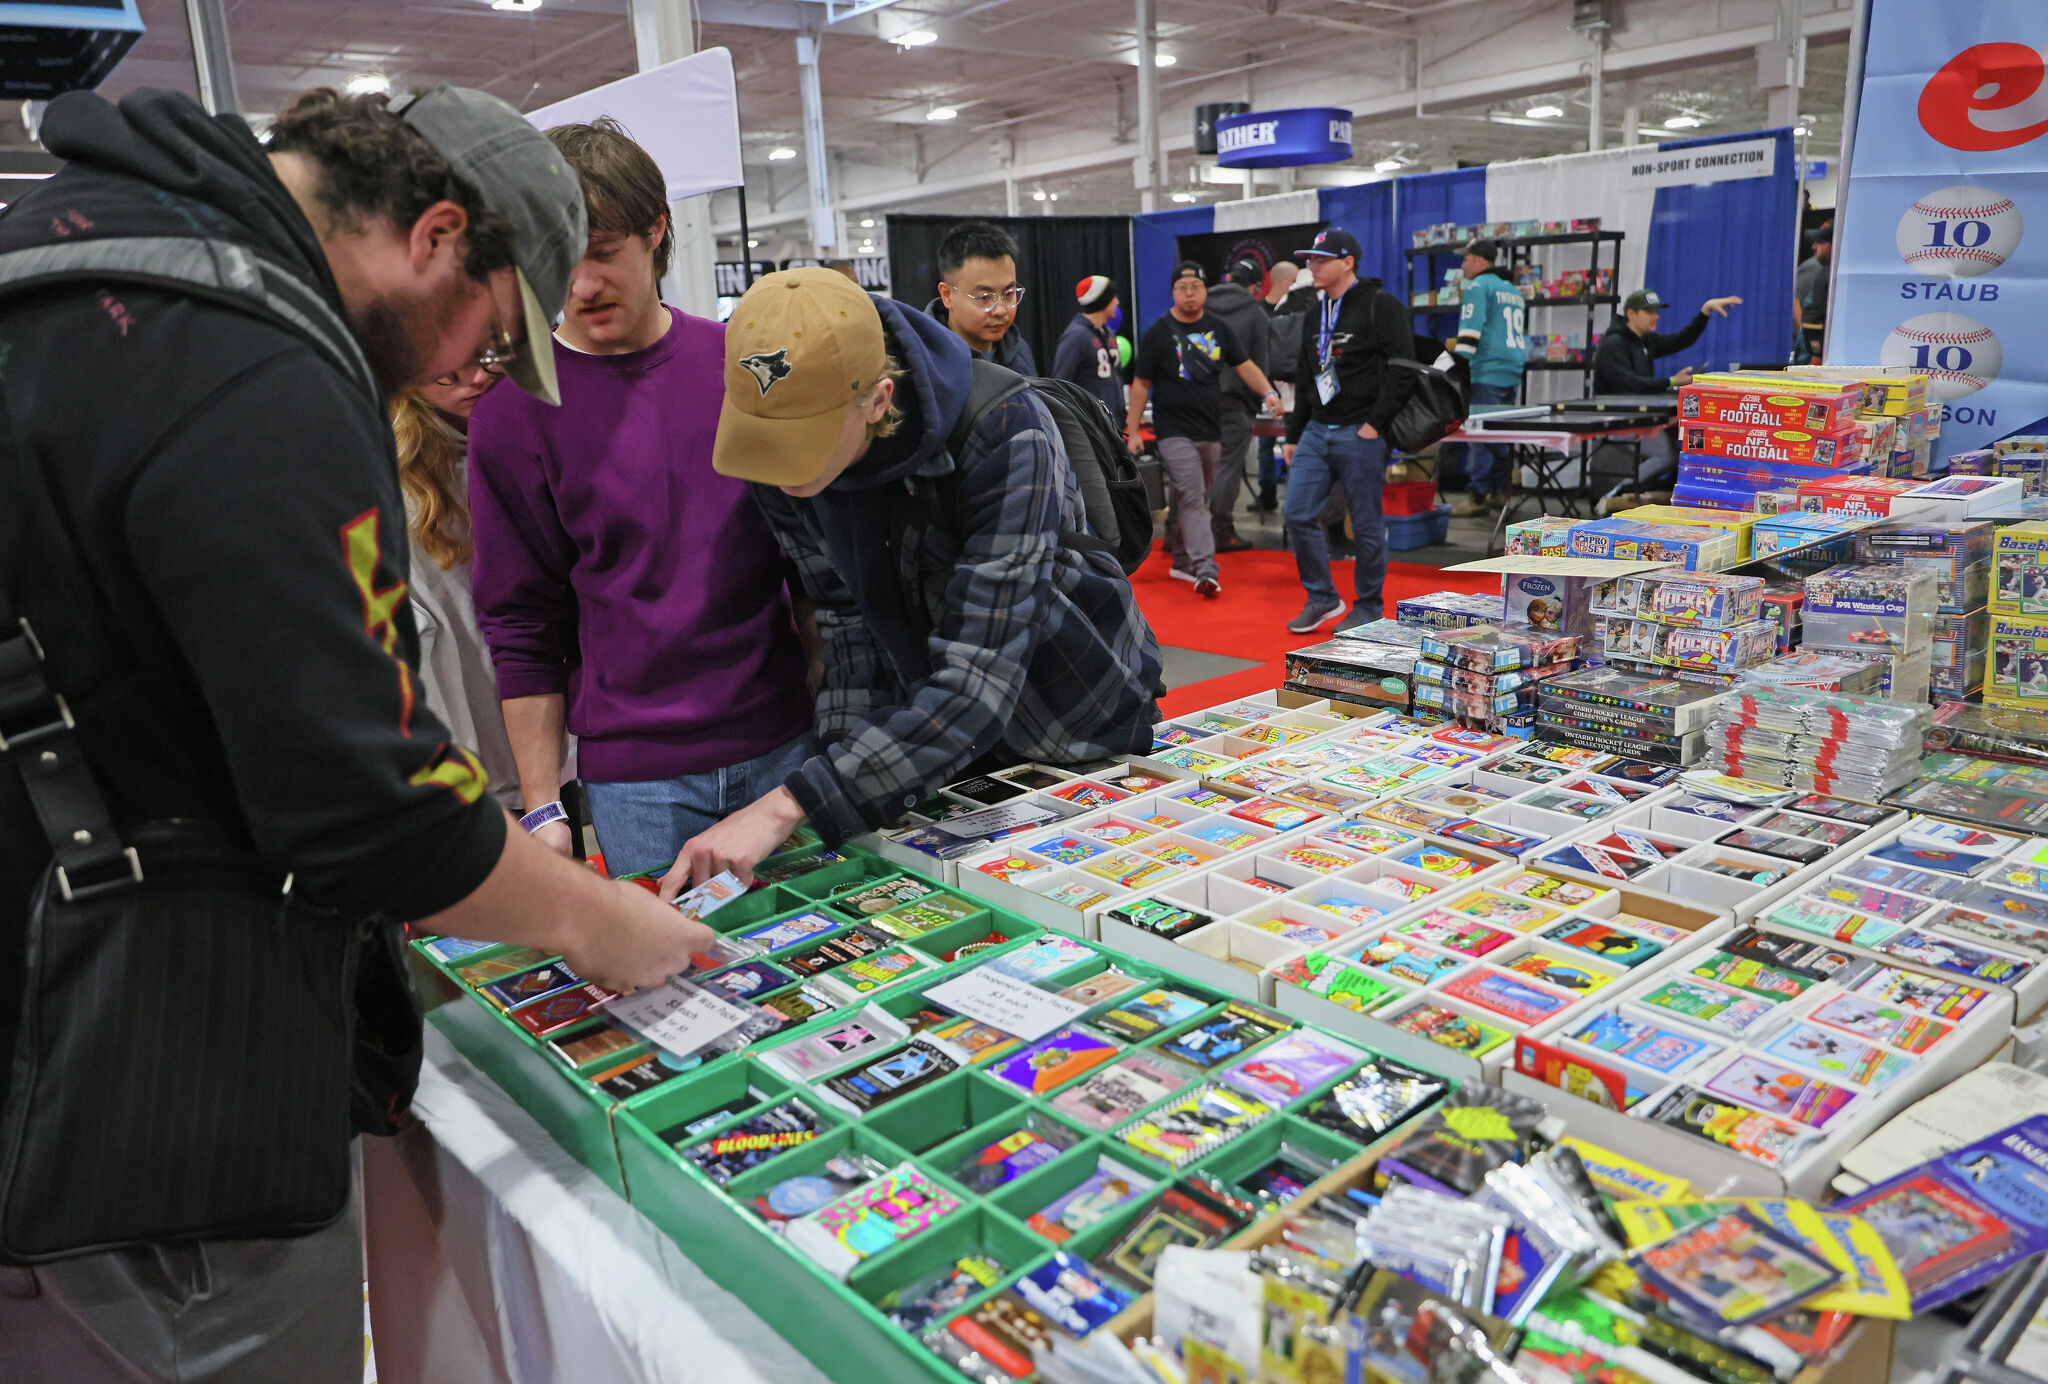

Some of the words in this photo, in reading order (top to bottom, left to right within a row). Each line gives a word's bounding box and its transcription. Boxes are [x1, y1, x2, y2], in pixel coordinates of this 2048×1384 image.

[1632, 158, 1691, 176] NON-SPORT
[1695, 150, 1765, 168] CONNECTION
[1923, 221, 1991, 248] 10
[1901, 282, 1999, 301] STAUB
[1461, 303, 1474, 320] 19
[1503, 306, 1526, 350] 19
[1910, 345, 1973, 371] 10
[1739, 402, 1766, 413] NFL
[1941, 405, 1996, 427] SON
[1720, 410, 1782, 427] FOOTBALL
[1745, 437, 1773, 447] NFL
[1726, 444, 1790, 461] FOOTBALL
[1702, 467, 1723, 475] 1989
[1844, 501, 1870, 511] NFL
[1588, 544, 1607, 555] SET
[1589, 536, 1608, 546] PRO
[1542, 546, 1567, 558] BASE
[1522, 580, 1551, 592] FROZEN
[1652, 588, 1718, 619] HOCKEY
[1836, 601, 1851, 609] 1991
[1852, 602, 1885, 611] Winston
[1886, 604, 1905, 613] Cup
[1424, 611, 1467, 629] BASEBALL
[1423, 638, 1449, 659] T2
[1496, 649, 1520, 666] T2
[1667, 632, 1733, 664] HOCKEY
[1336, 679, 1368, 690] PARKHURST
[1415, 663, 1444, 681] T2
[1497, 674, 1522, 692] T2
[1417, 684, 1444, 704] T2
[1494, 693, 1518, 713] T2
[1565, 703, 1593, 714] ONTARIO
[1593, 707, 1620, 719] HOCKEY
[1620, 713, 1646, 724] LEAGUE
[1573, 711, 1614, 725] COLLECTOR'S
[1614, 718, 1637, 728] CARDS
[1565, 731, 1595, 743] ONTARIO
[1595, 736, 1623, 748] HOCKEY
[1623, 742, 1651, 752] LEAGUE
[1573, 739, 1618, 752] COLLECTOR'S
[1618, 746, 1641, 757] CARDS
[1343, 832, 1382, 844] BIG
[1295, 856, 1331, 869] BIG
[699, 996, 718, 1013] Wax
[719, 1008, 740, 1022] Packs
[717, 1130, 814, 1153] BLOODLINES
